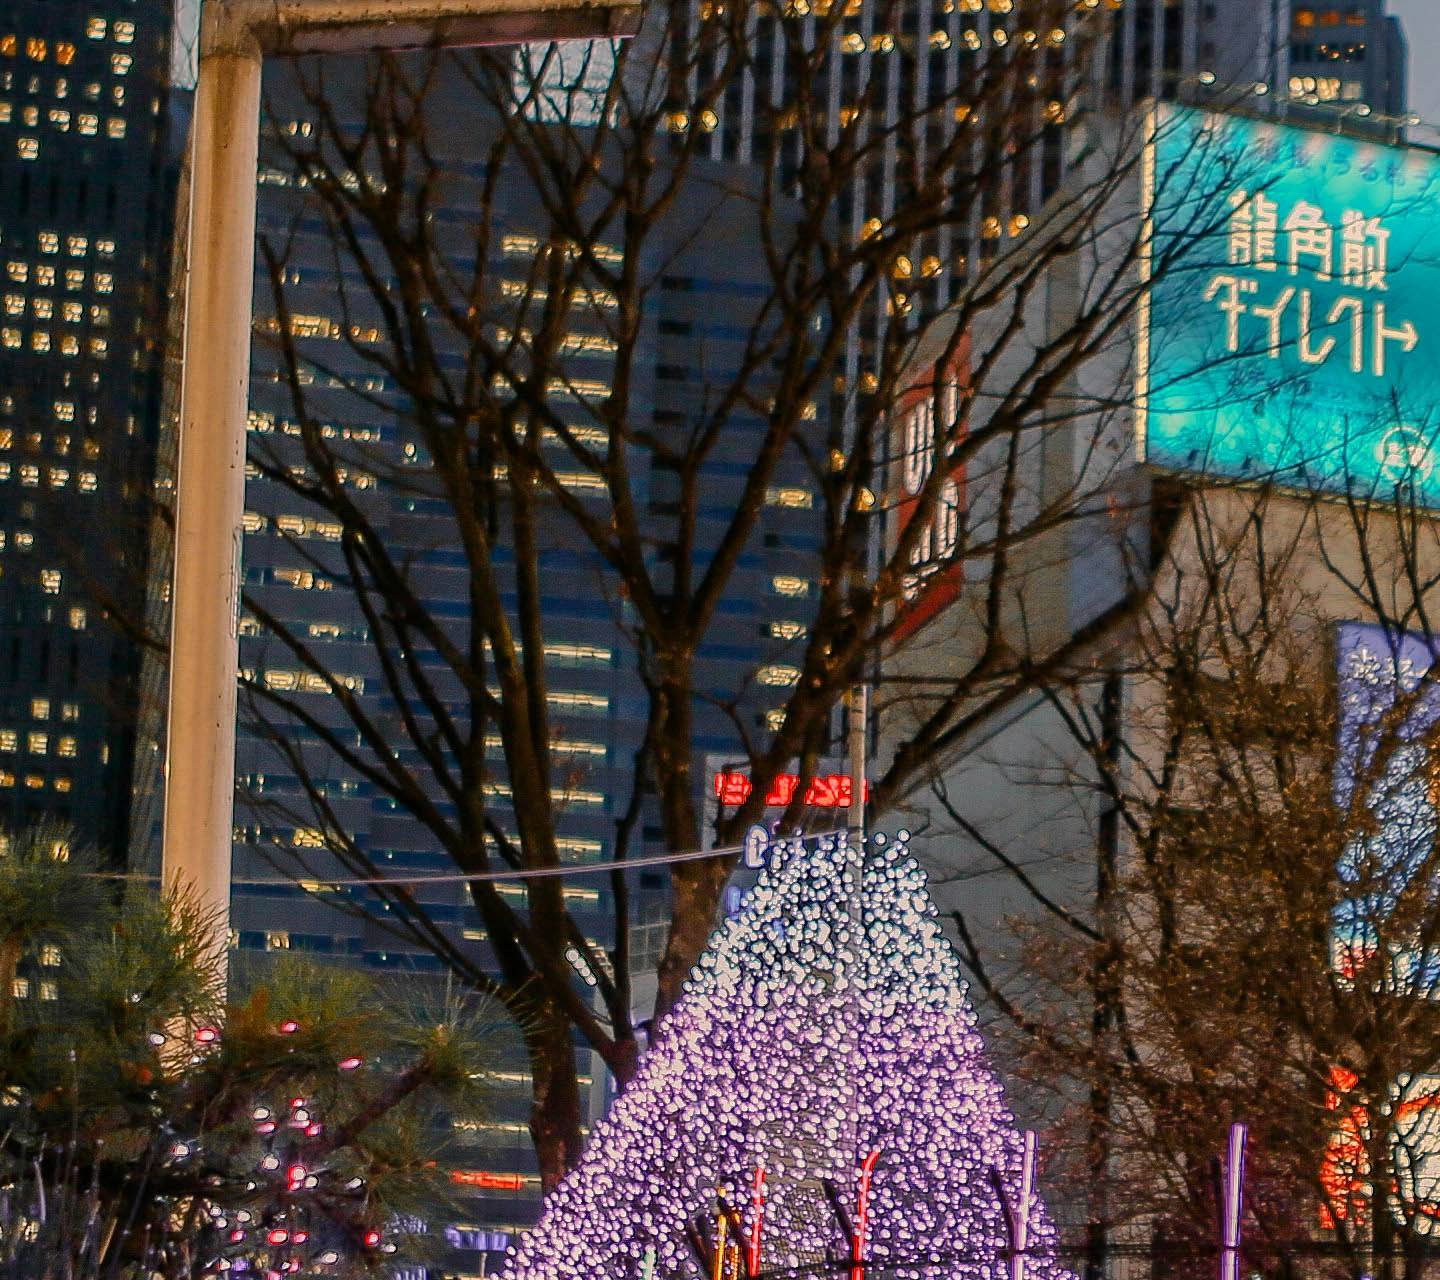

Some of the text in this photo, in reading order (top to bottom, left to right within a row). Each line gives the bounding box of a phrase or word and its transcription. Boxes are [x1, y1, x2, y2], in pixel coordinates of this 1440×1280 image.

[1226, 189, 1391, 292] 龍角散
[1204, 276, 1419, 376] ダイレクト
